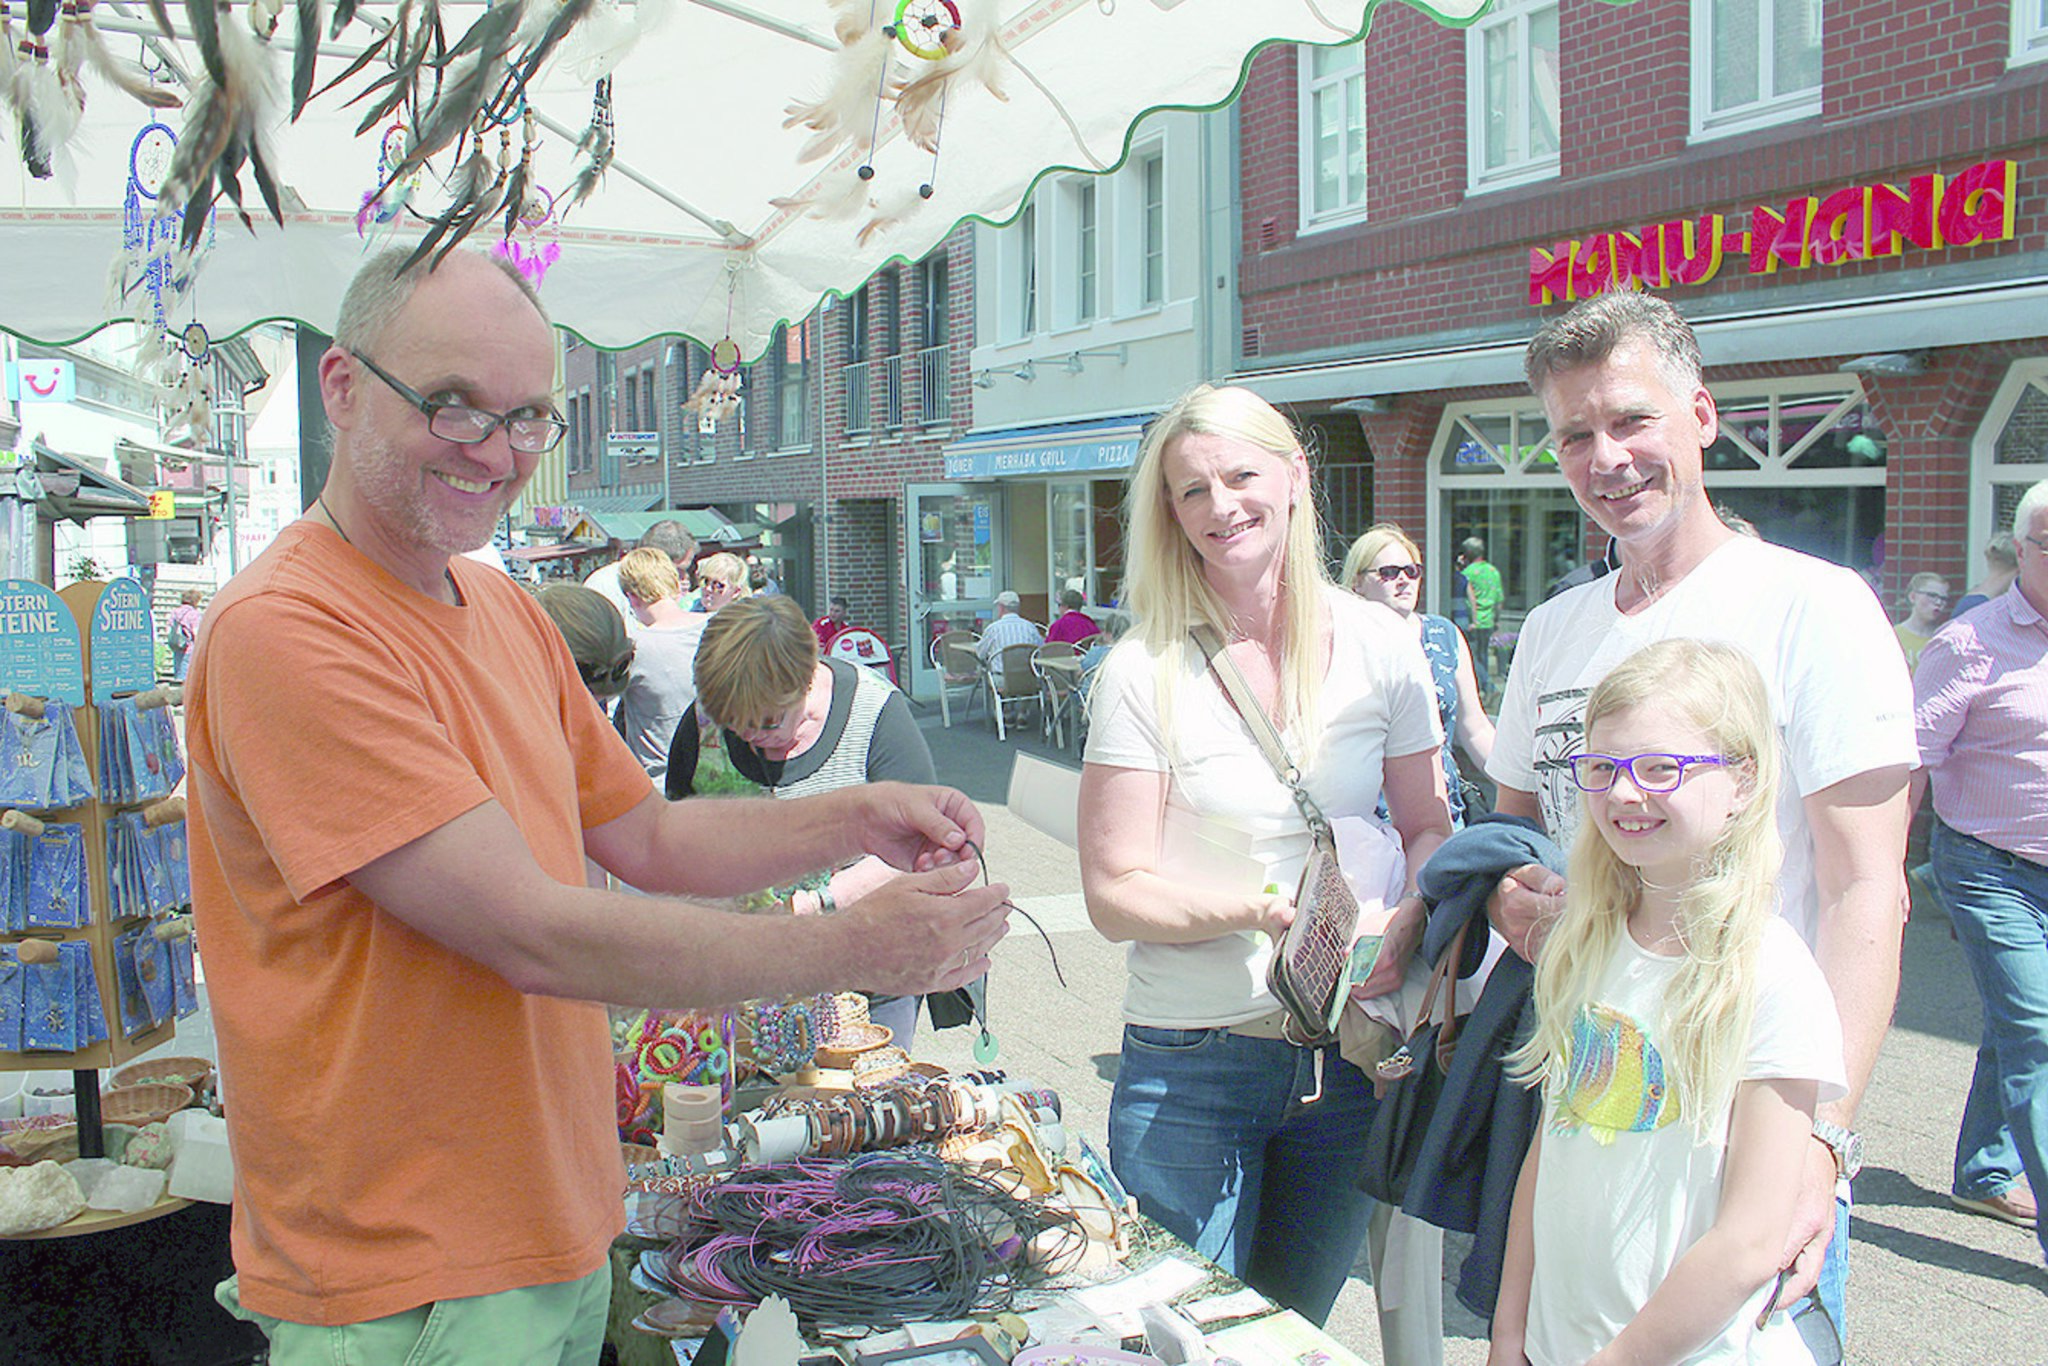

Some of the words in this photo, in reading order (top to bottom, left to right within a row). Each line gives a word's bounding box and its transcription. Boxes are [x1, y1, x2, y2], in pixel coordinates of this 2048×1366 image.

[1098, 444, 1129, 463] PIZZA
[110, 587, 140, 608] STERN
[100, 599, 144, 631] STEINE
